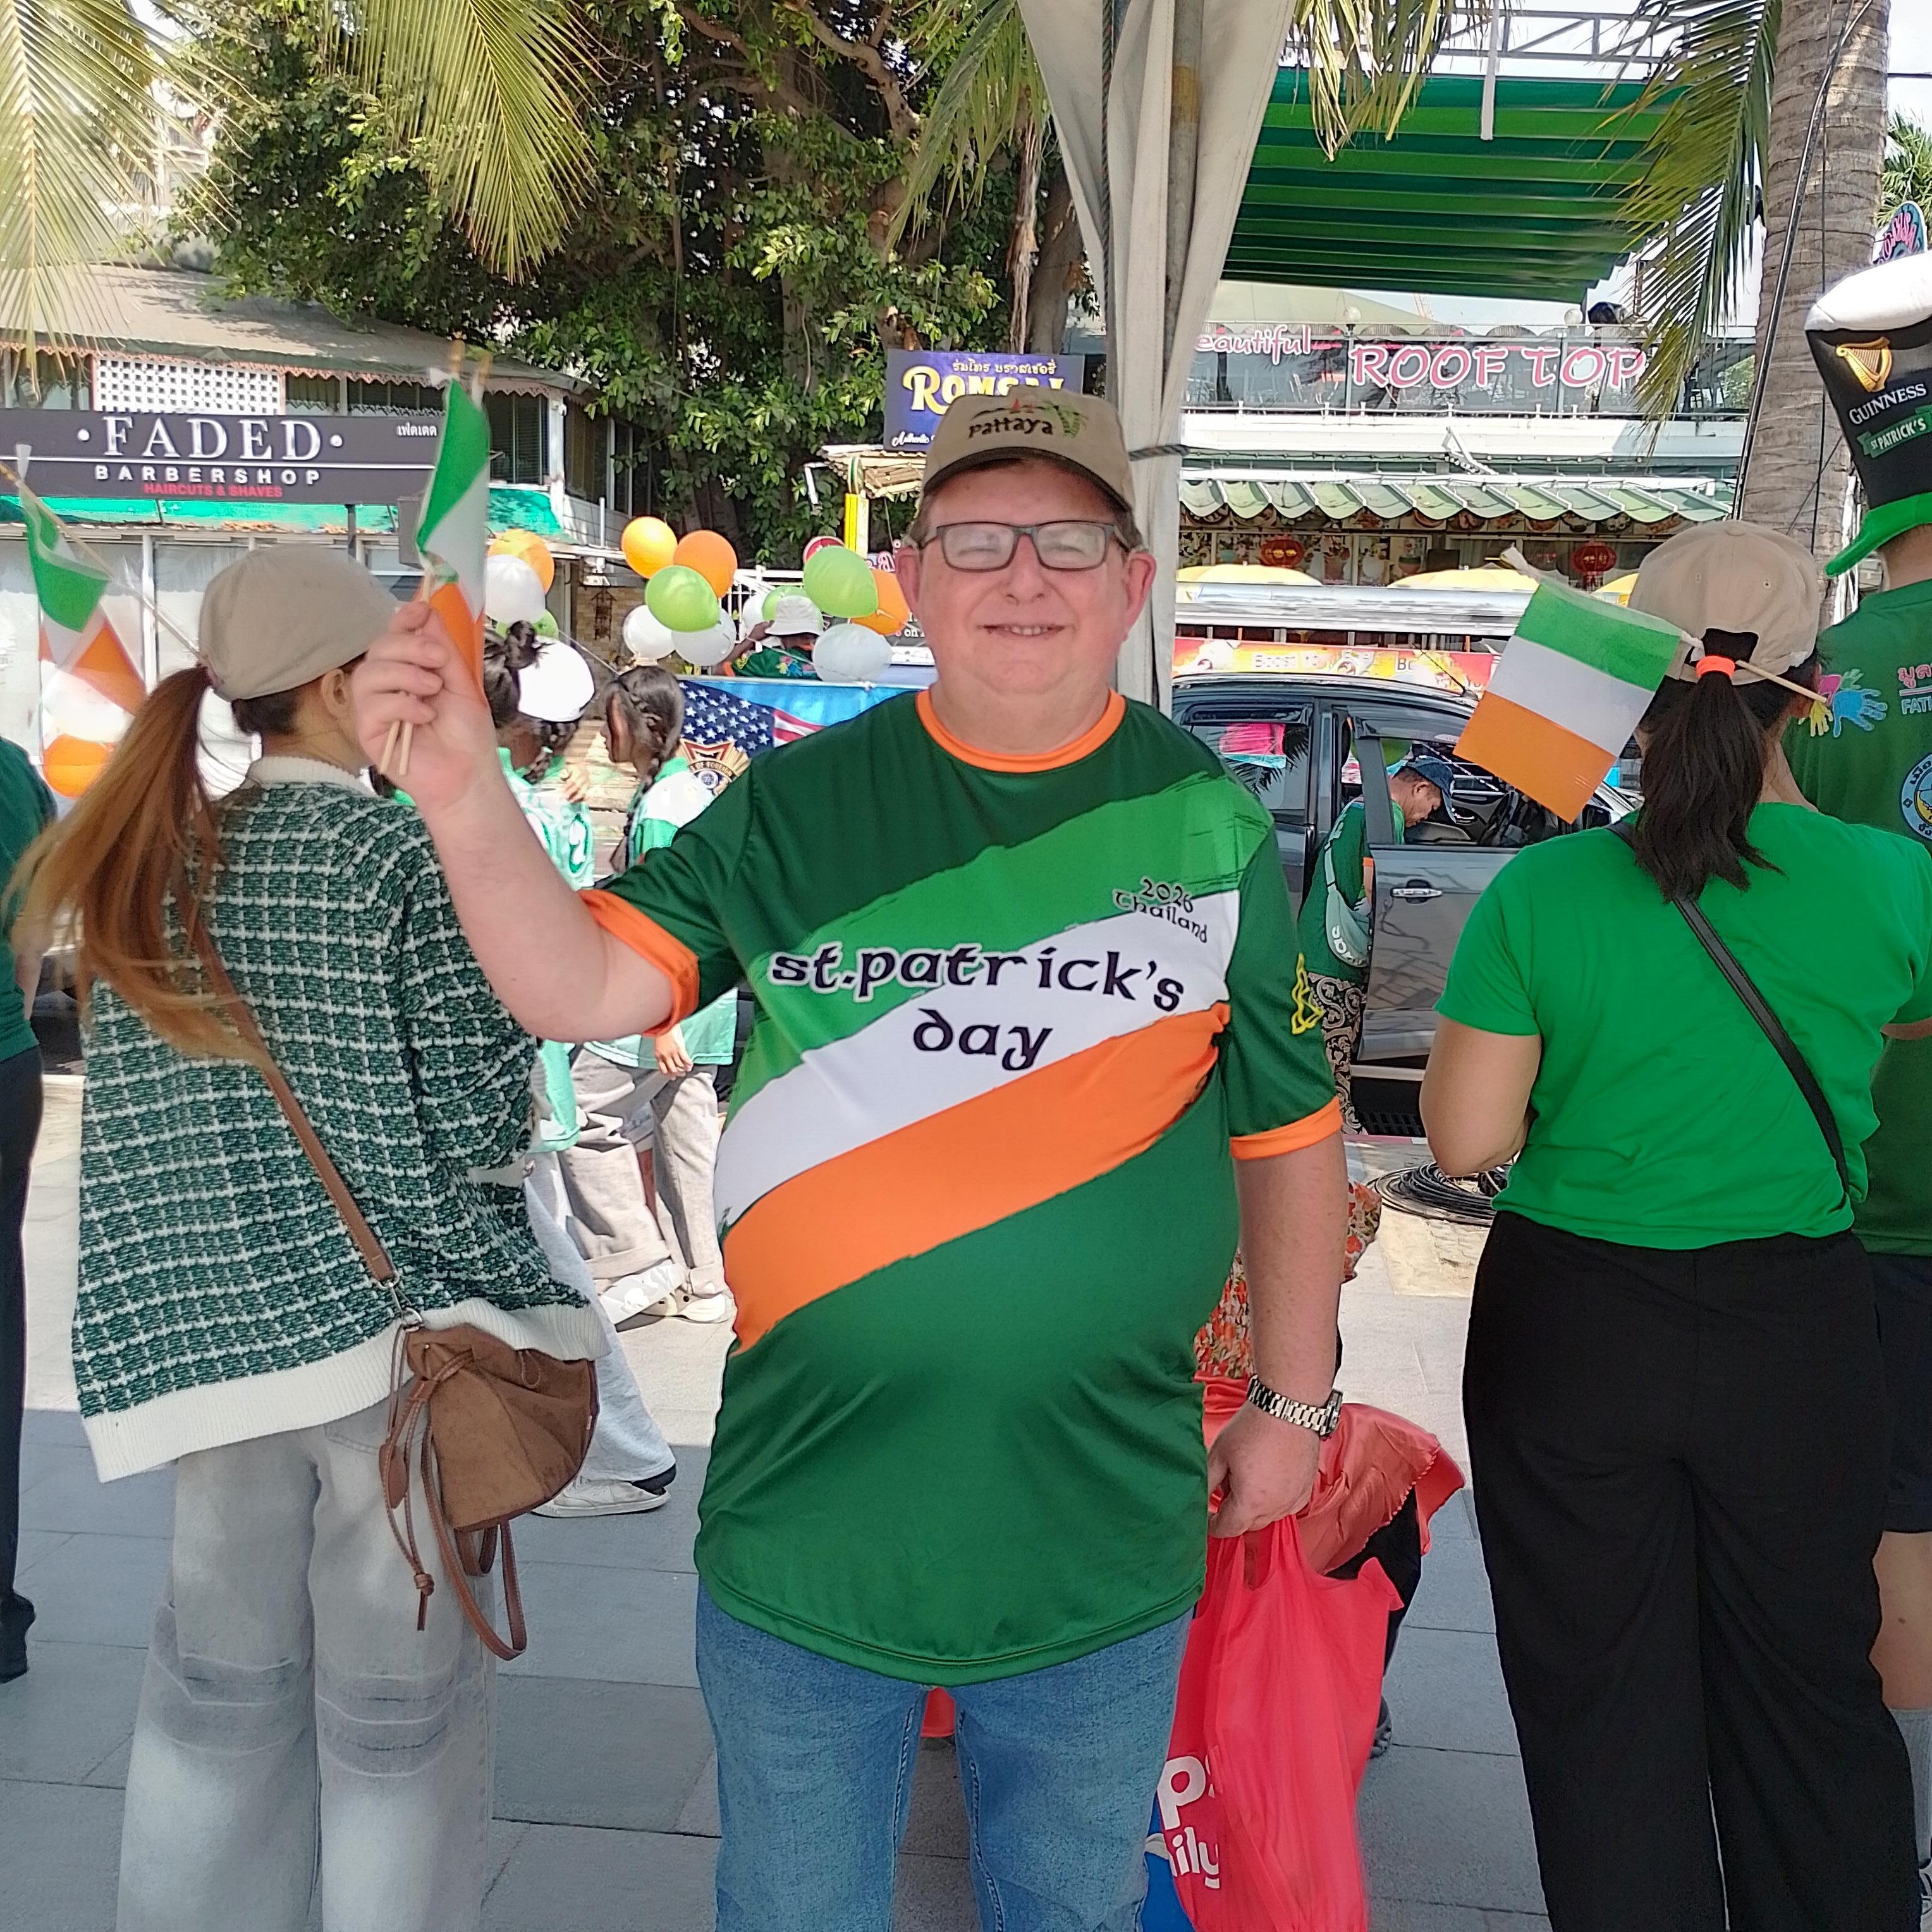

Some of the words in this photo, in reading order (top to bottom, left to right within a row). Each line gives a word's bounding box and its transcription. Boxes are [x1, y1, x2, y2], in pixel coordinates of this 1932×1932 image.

[1350, 345, 1509, 391] ROOF
[1519, 346, 1646, 389] TOP
[1849, 383, 1927, 425] GUINNESS
[102, 415, 322, 462] FADED
[1878, 417, 1927, 450] PATRICK'S
[94, 464, 320, 486] BARBERSHOP
[144, 482, 214, 496] HAIRCUTS
[216, 486, 226, 497] &
[228, 484, 283, 498] SHAVES
[1142, 878, 1194, 914] 2026
[1116, 891, 1208, 944] Thailand
[912, 1008, 1053, 1071] day
